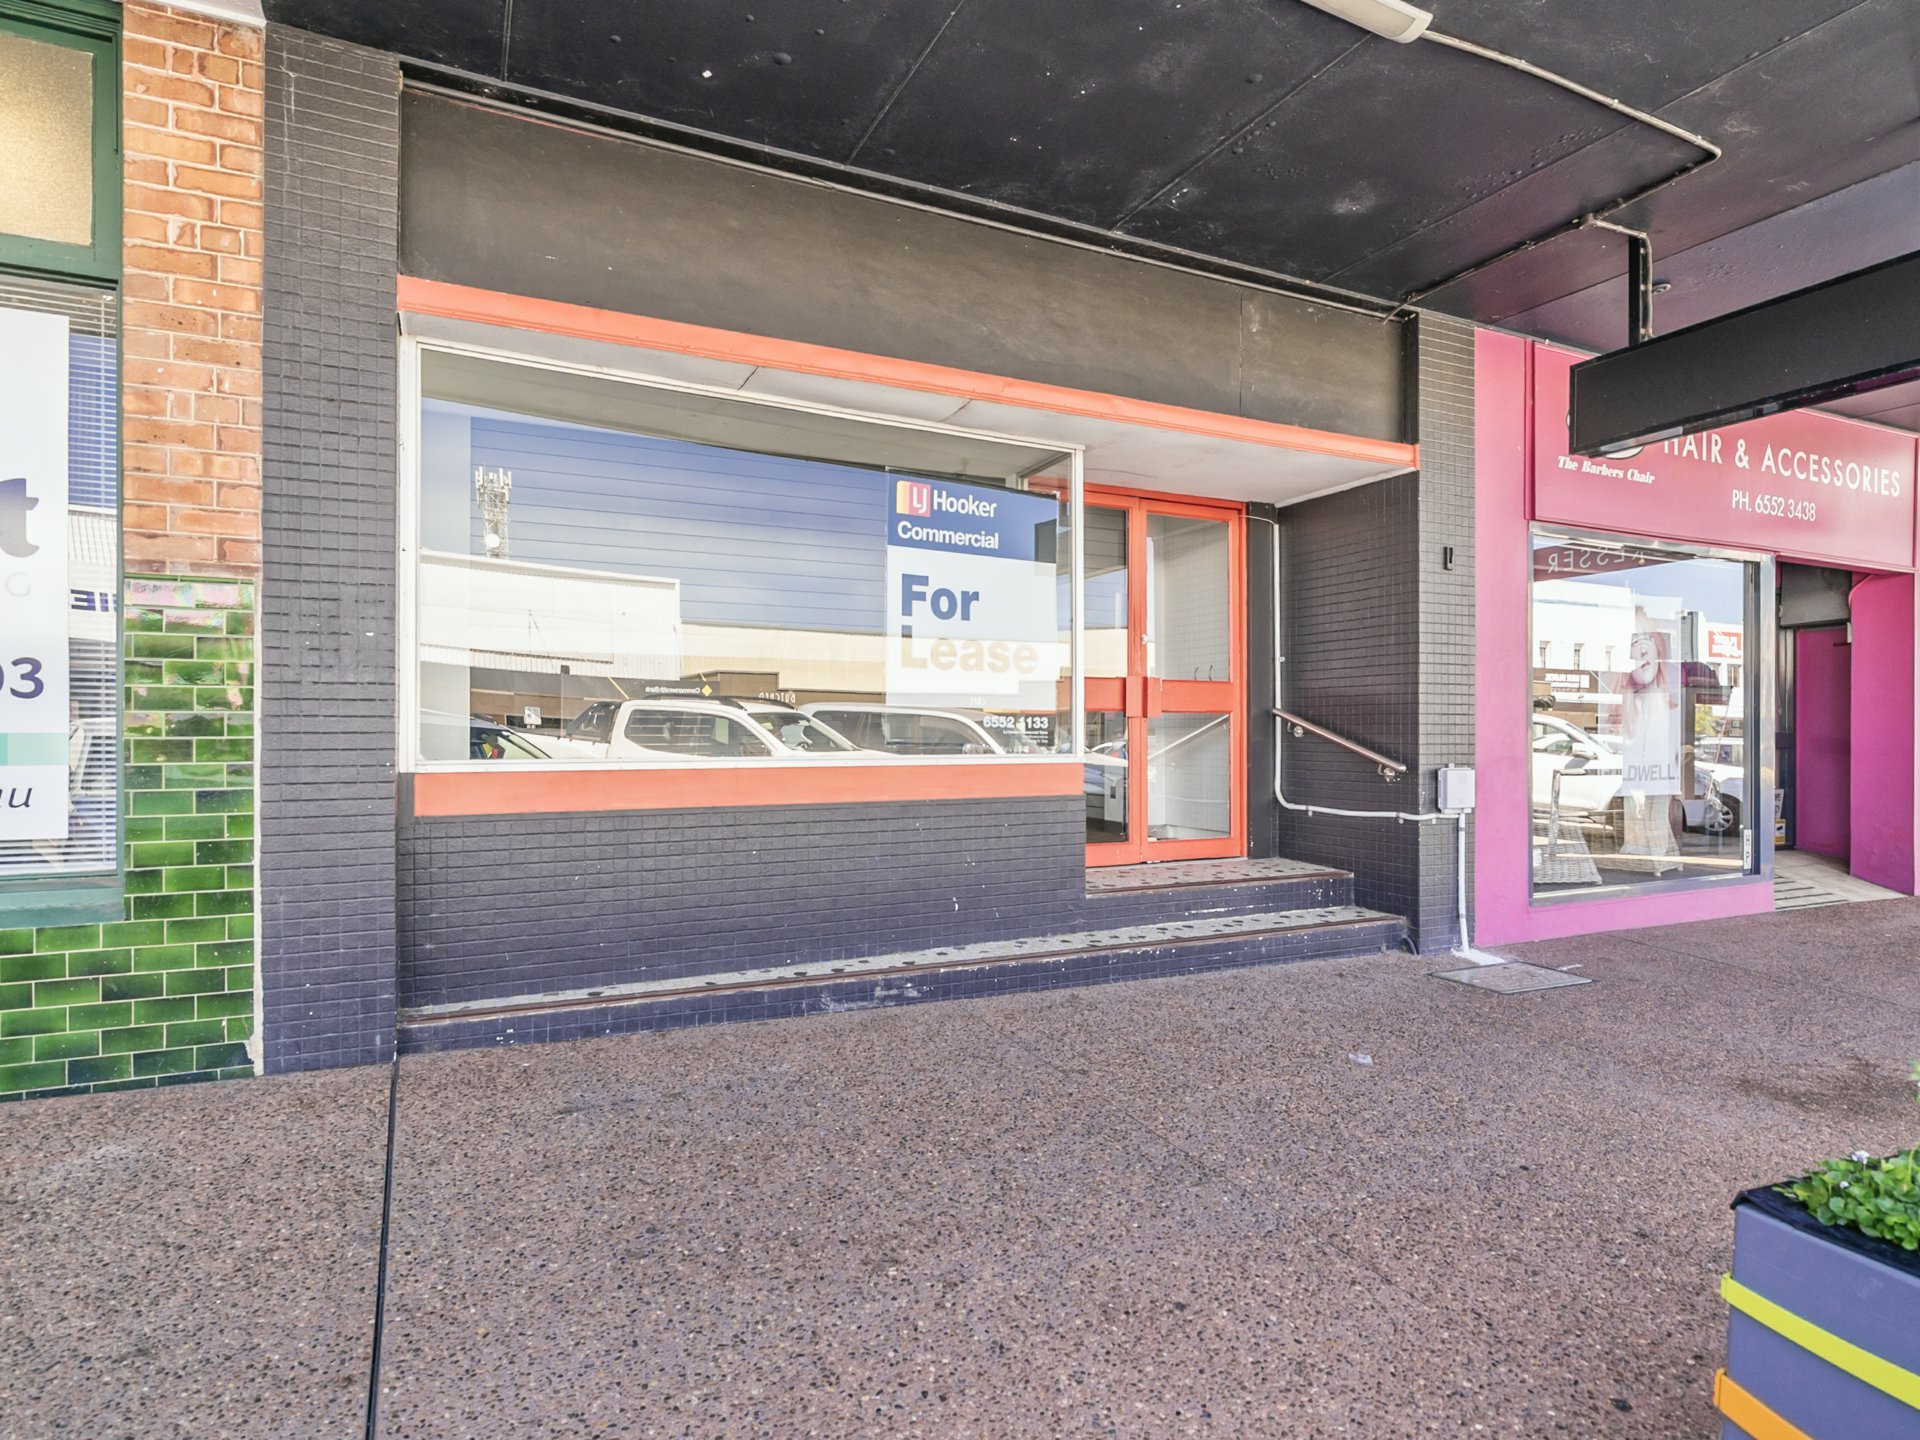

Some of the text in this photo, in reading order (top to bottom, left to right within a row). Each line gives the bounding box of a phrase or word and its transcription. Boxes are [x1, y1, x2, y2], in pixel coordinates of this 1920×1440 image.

[1558, 456, 1656, 484] The Barbers Chair
[1735, 439, 1750, 469] &
[1760, 443, 1901, 498] ACCESSORIES
[933, 489, 998, 518] Hooker
[1732, 489, 1817, 522] PH. 6552 3438
[897, 520, 999, 550] Commercial
[902, 573, 980, 621] For
[901, 624, 1038, 674] Lease
[983, 716, 1015, 728] 6552
